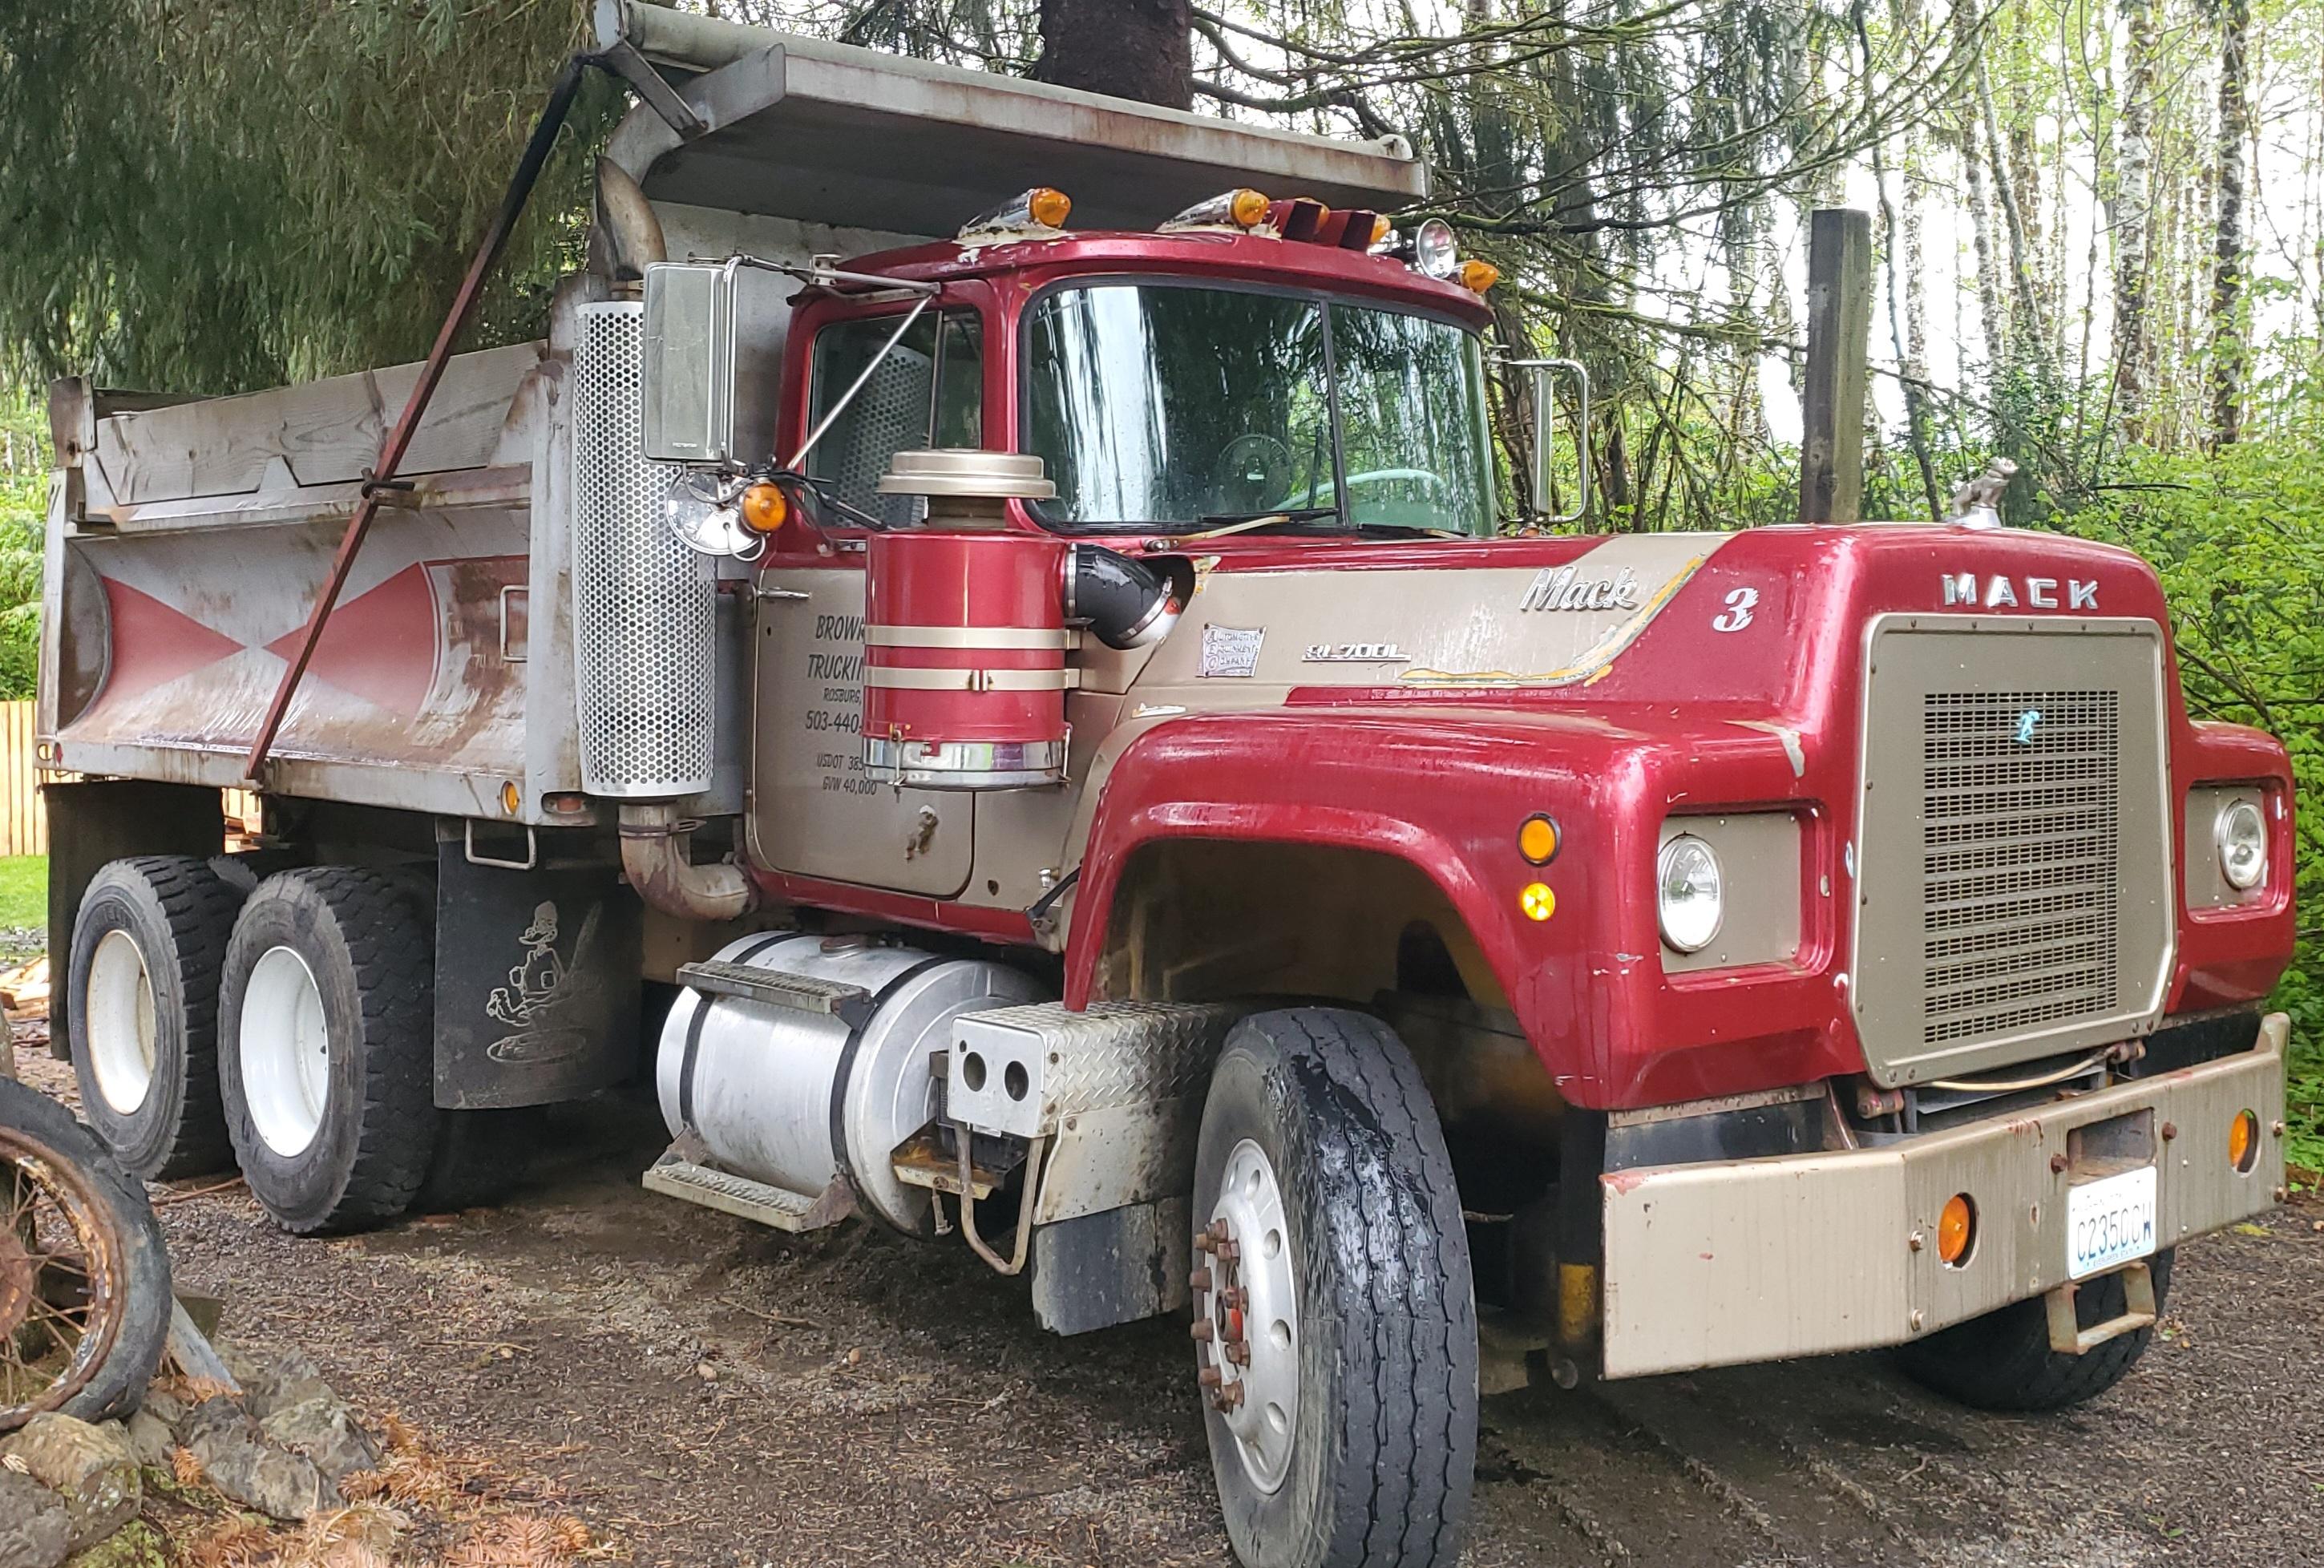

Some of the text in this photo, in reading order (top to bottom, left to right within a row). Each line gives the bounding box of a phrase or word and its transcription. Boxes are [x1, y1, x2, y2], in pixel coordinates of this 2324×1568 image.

[1519, 565, 1639, 611] Mack
[1941, 573, 2100, 609] MACK
[1712, 588, 1760, 632] 3
[817, 754, 844, 770] USDOT
[823, 776, 877, 796] GVW 40,000
[2077, 1201, 2152, 1262] C23500W
